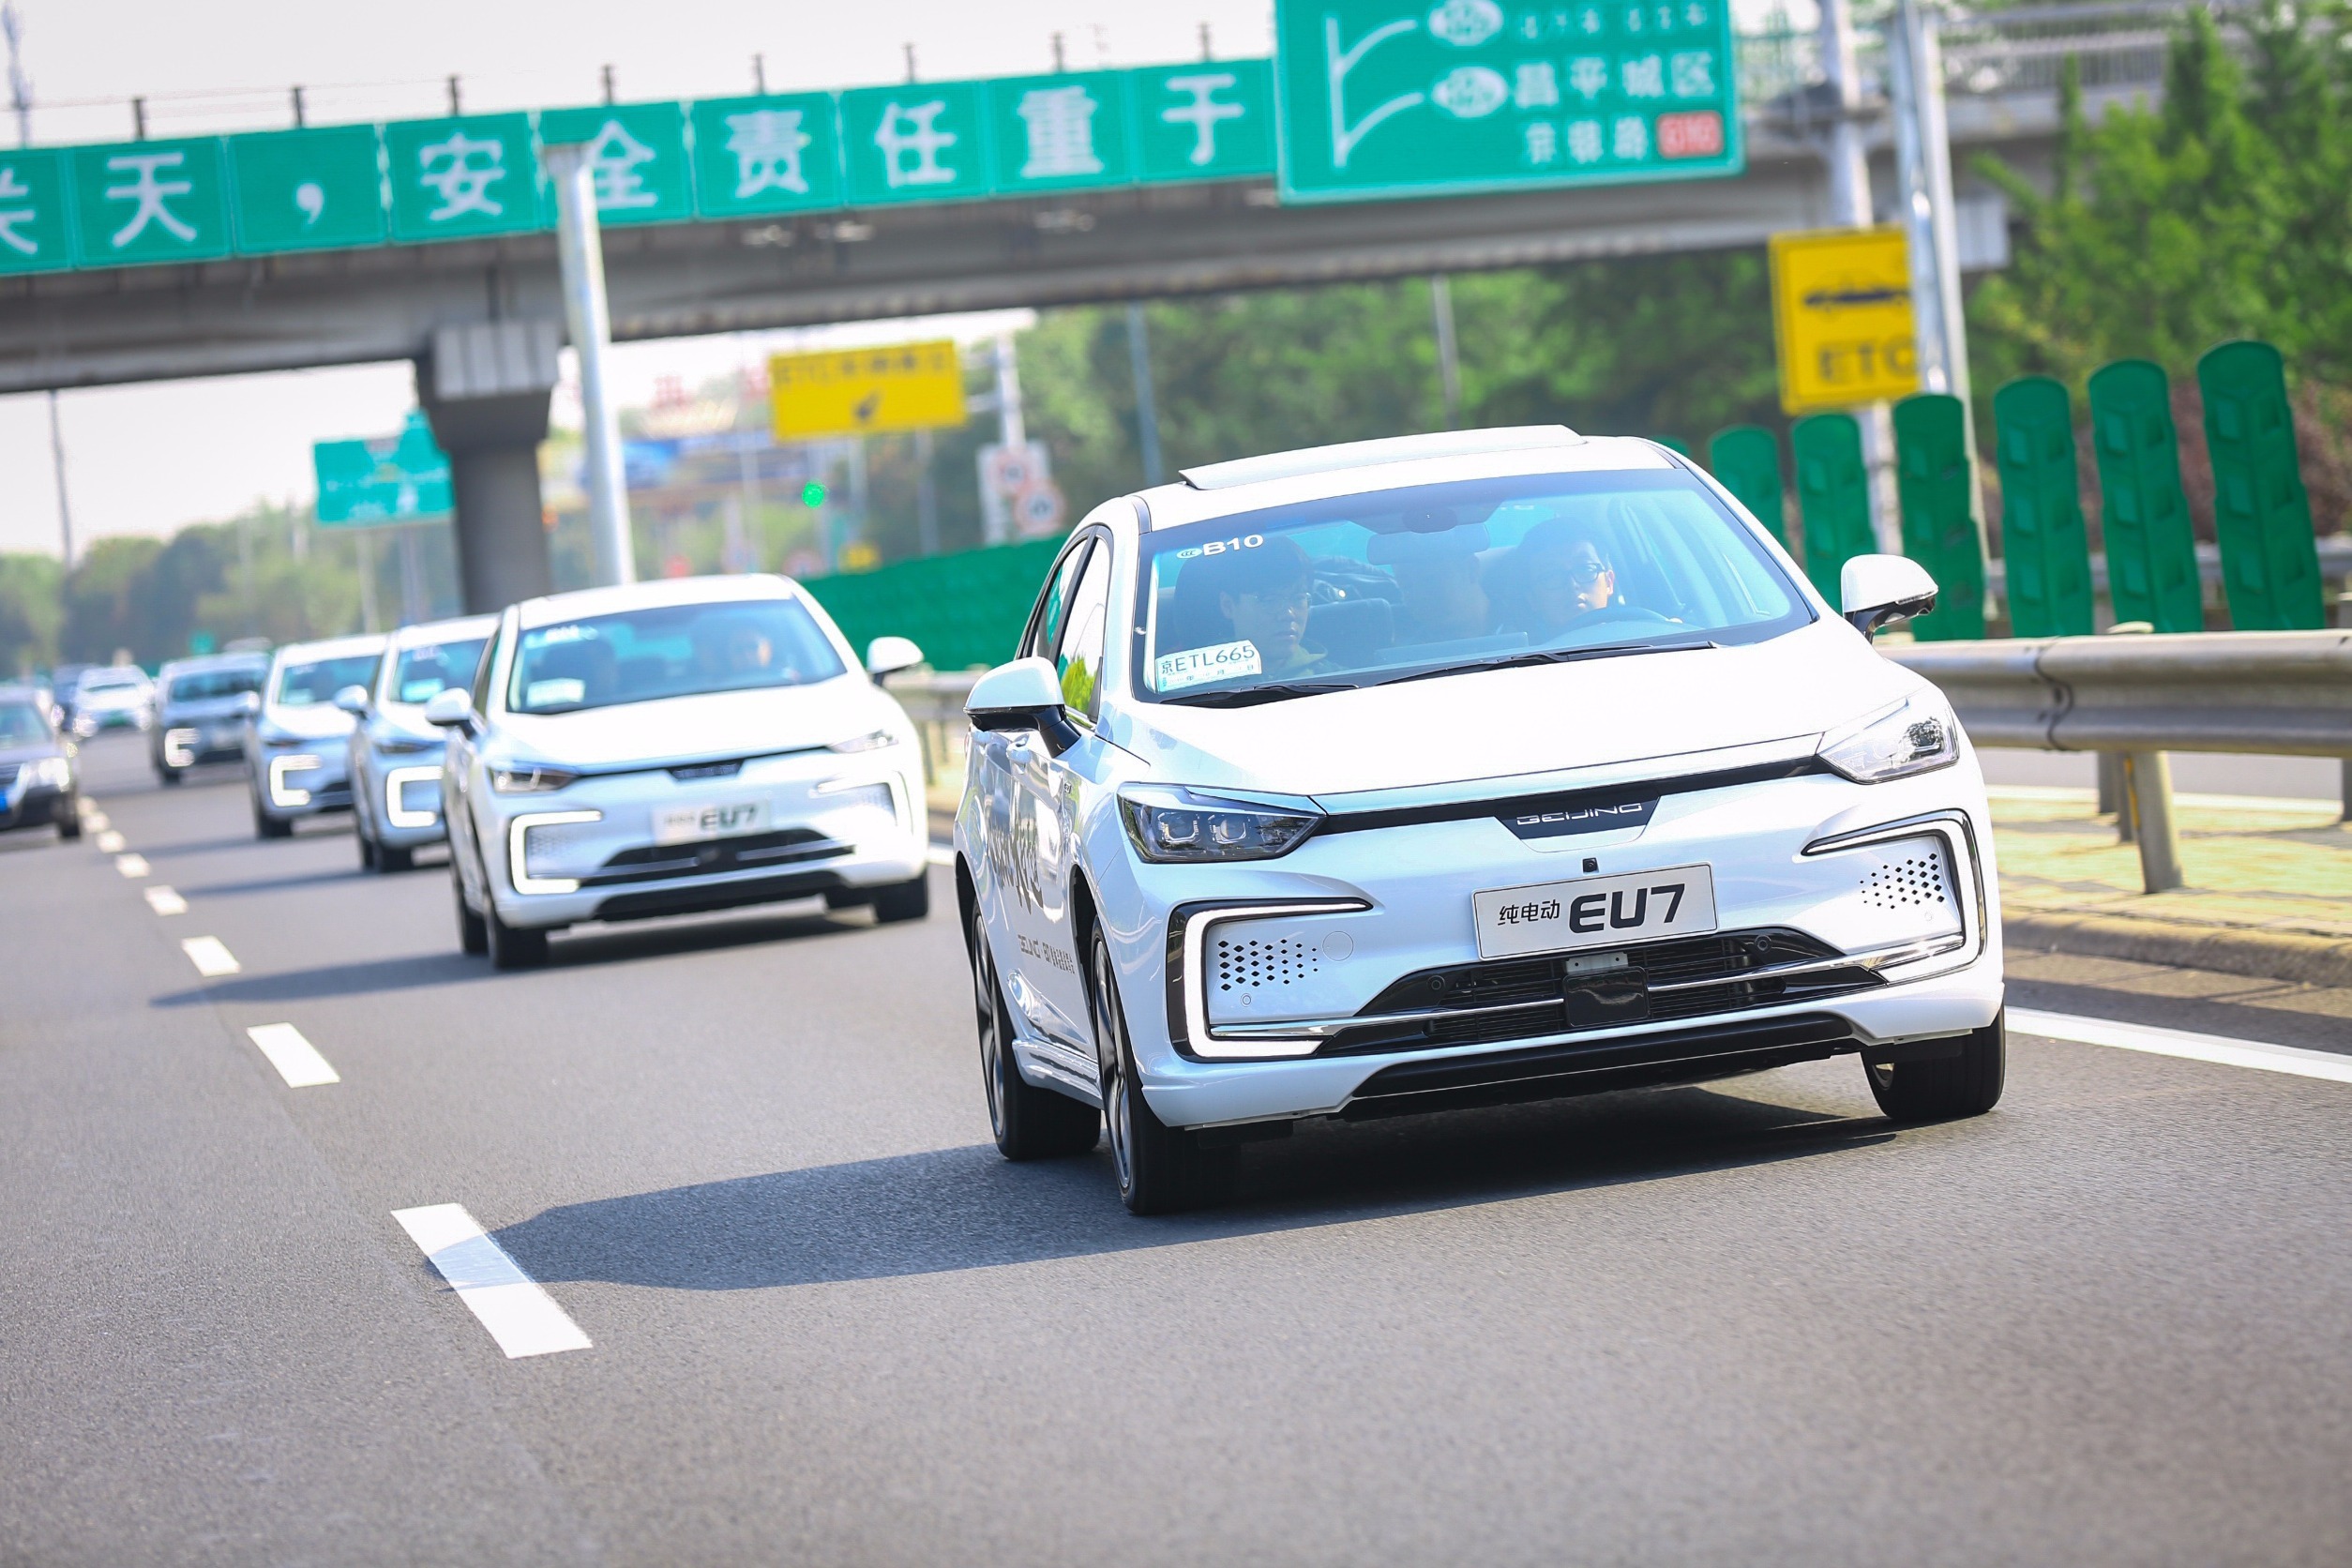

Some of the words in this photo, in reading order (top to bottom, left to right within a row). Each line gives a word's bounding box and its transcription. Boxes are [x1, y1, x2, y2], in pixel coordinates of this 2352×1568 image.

[1202, 534, 1264, 556] B10
[700, 803, 758, 830] EU7
[1516, 802, 1643, 826] BEIJING
[1497, 898, 1560, 926] 纯电动
[1569, 882, 1686, 934] EU7
